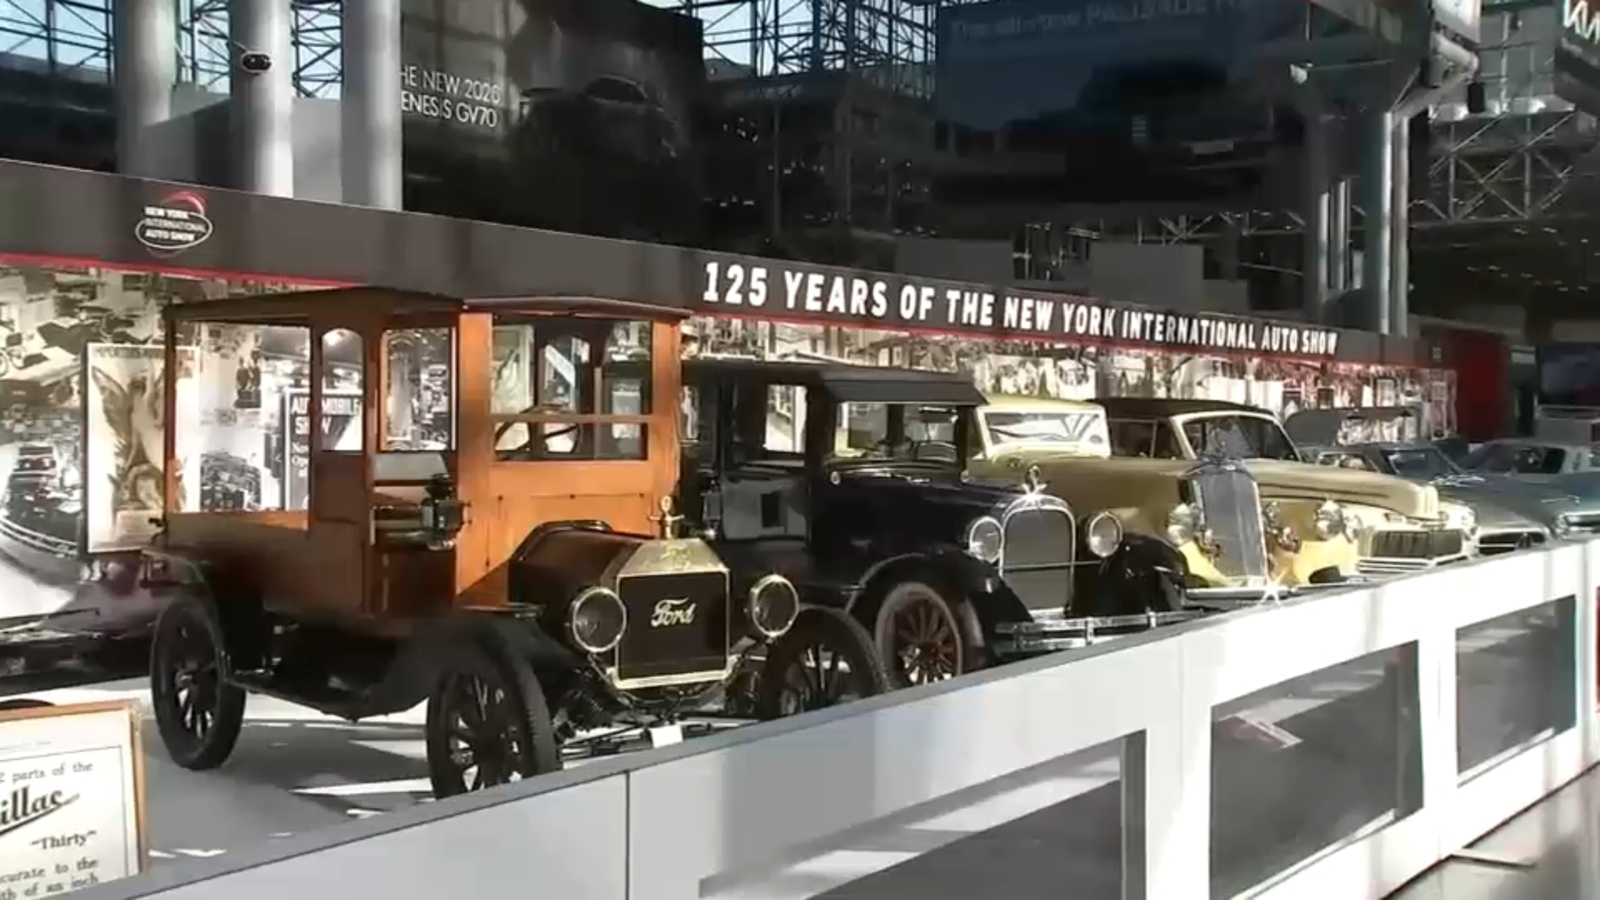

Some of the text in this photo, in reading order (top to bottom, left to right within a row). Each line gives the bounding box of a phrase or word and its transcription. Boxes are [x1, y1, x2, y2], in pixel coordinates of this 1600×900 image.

[422, 70, 461, 96] NEW
[456, 102, 498, 127] GV70
[144, 206, 189, 219] NEW YORK
[145, 229, 195, 242] AUTO SHOW
[703, 262, 1339, 355] 125 YEARS OF THE NEW YORK INTERNATIONAL AUTO SHOW
[651, 597, 697, 627] Ford
[13, 769, 46, 785] parts
[52, 763, 66, 777] of
[73, 761, 94, 773] the
[55, 862, 69, 875] to
[77, 856, 99, 871] the
[24, 881, 40, 897] of
[46, 882, 64, 893] an
